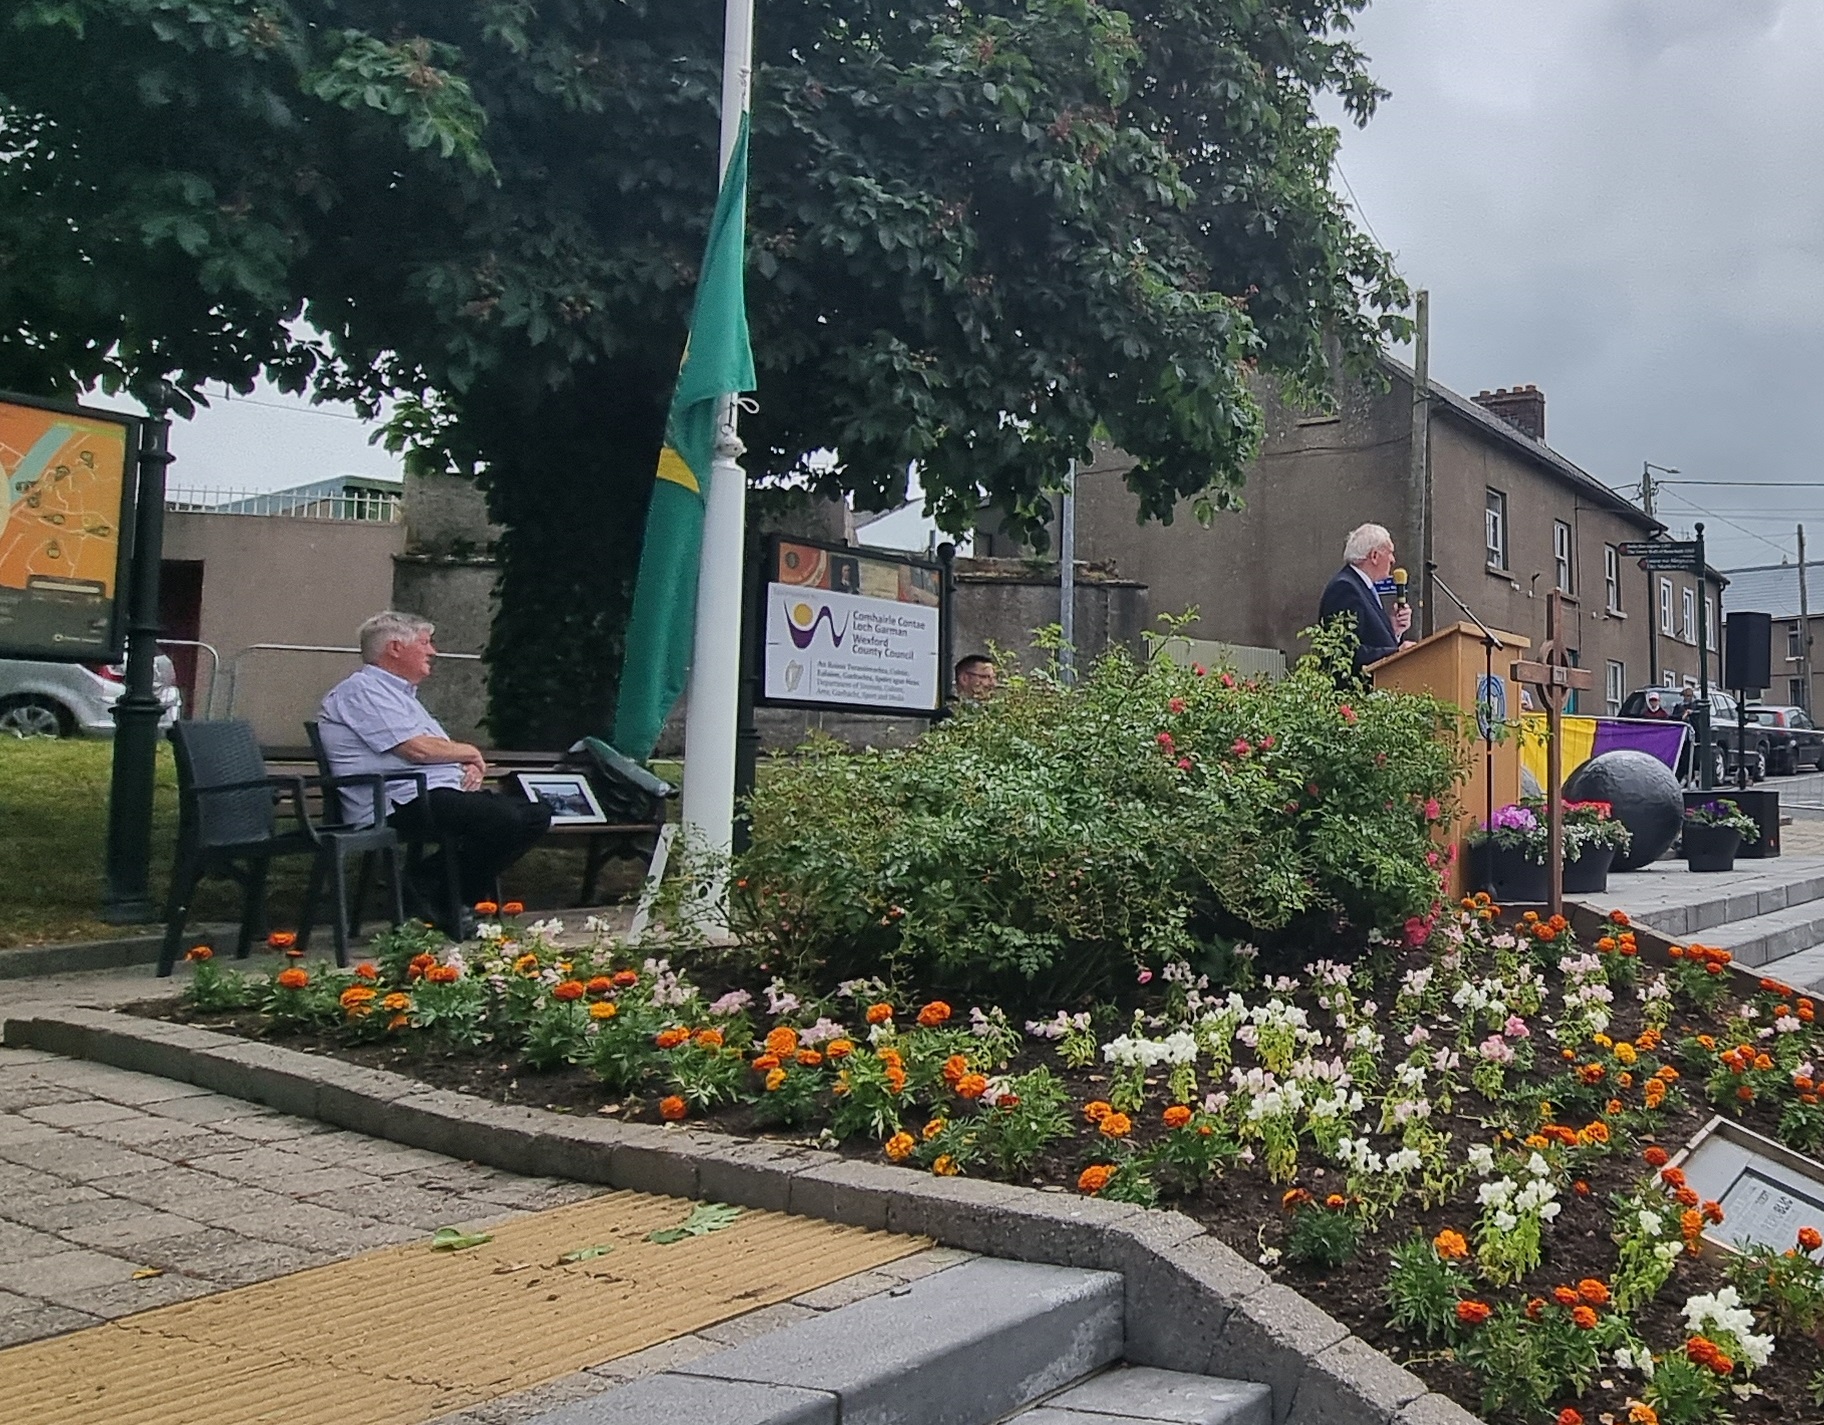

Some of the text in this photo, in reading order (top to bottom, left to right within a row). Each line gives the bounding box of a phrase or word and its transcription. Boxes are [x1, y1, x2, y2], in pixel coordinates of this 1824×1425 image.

[852, 620, 908, 637] Loch Garman
[853, 610, 926, 630] Comhairle Contae
[852, 633, 889, 648] Wexford
[852, 643, 914, 660] County Council
